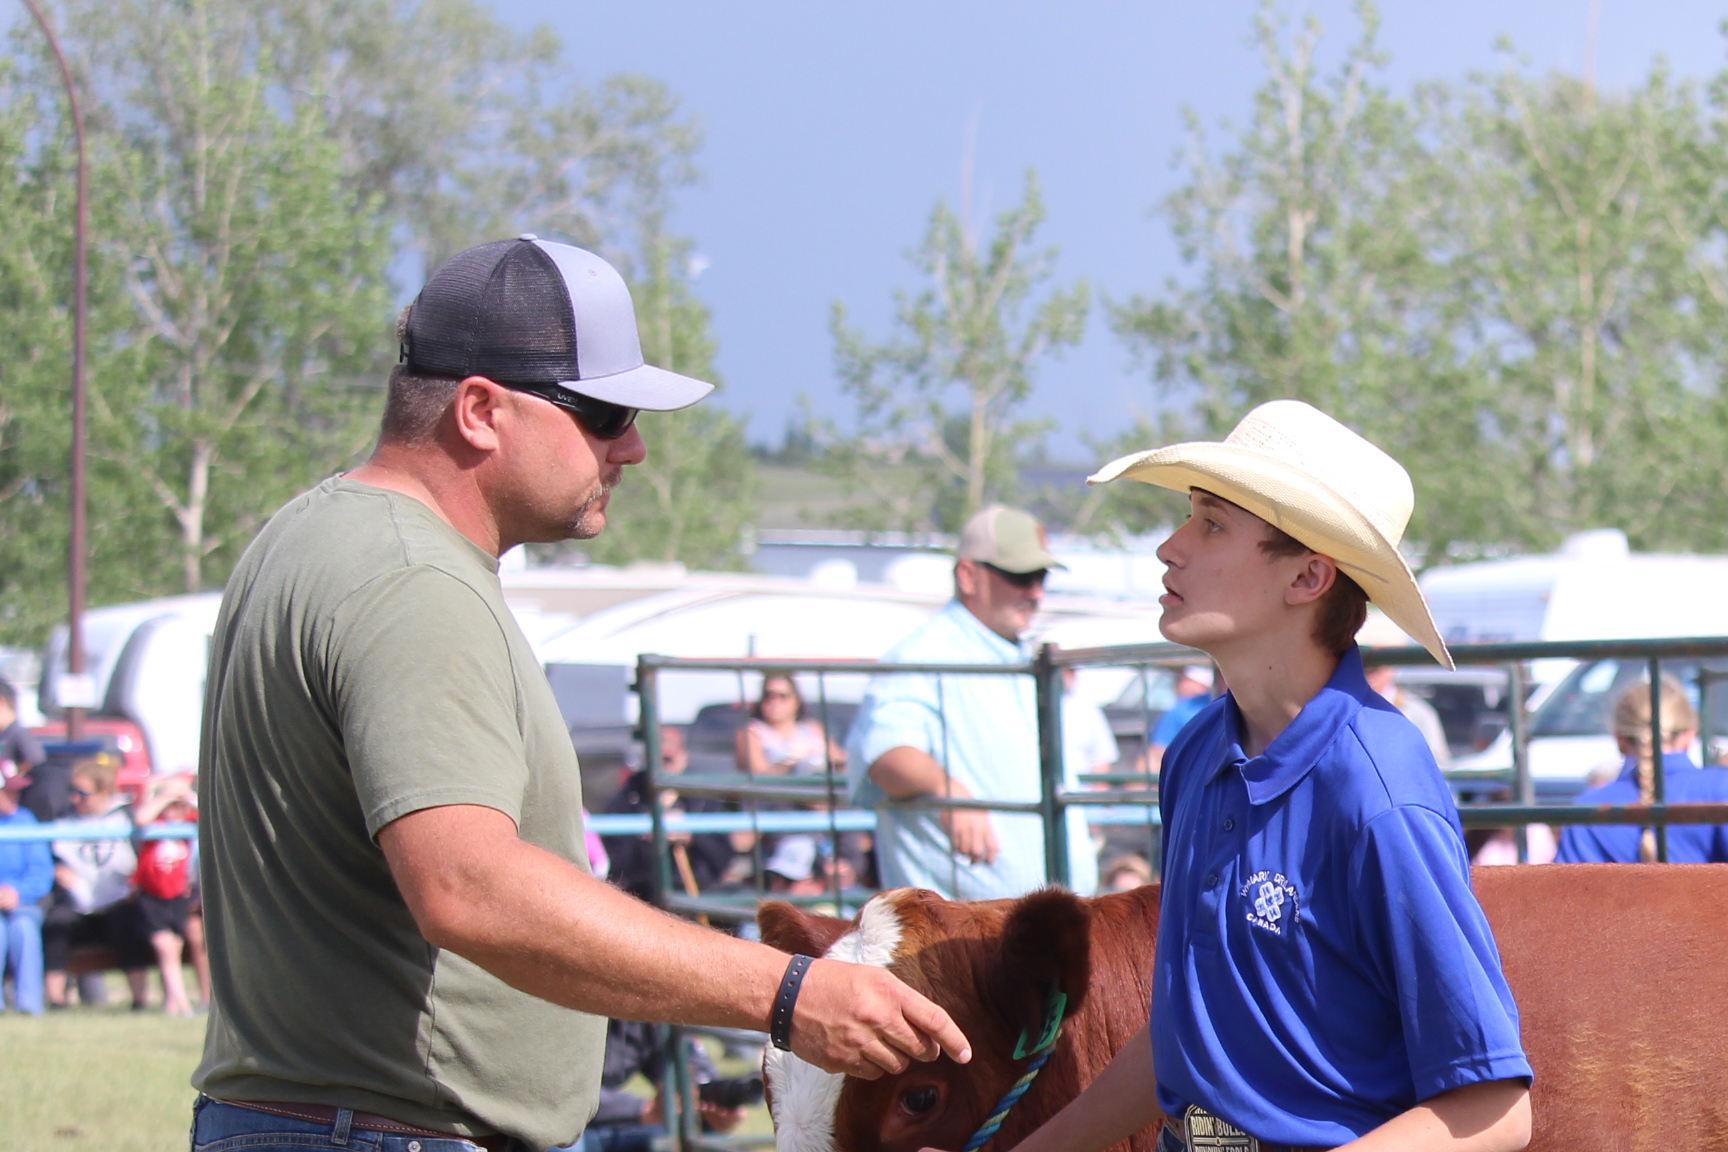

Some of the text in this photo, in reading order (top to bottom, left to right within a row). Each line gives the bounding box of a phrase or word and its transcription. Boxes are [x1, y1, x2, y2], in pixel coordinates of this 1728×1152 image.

[1246, 912, 1281, 935] CANADA
[1190, 1116, 1246, 1136] RIDIN' BUL
